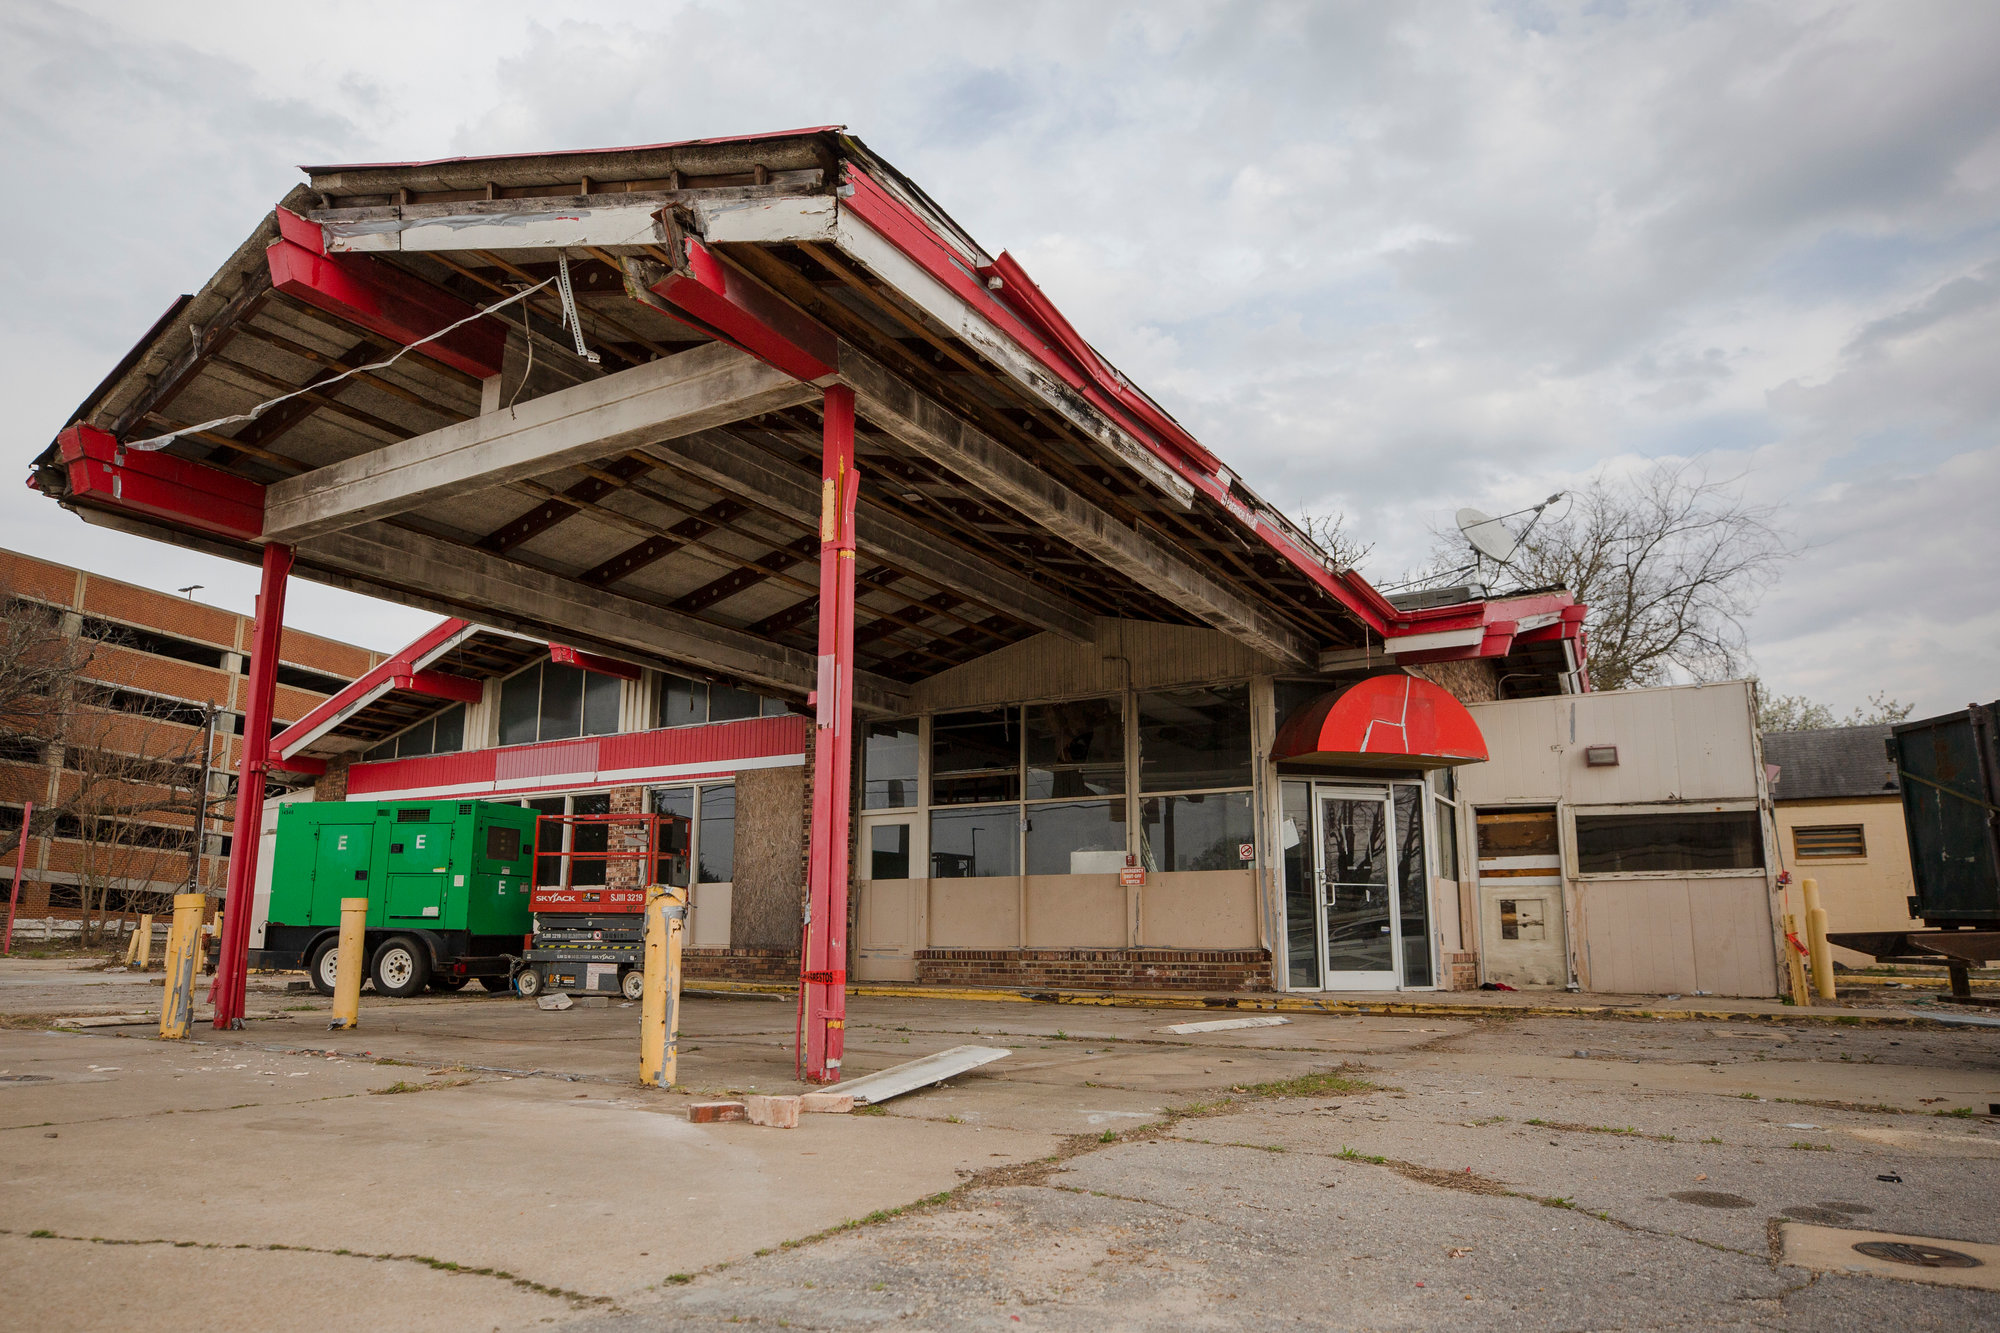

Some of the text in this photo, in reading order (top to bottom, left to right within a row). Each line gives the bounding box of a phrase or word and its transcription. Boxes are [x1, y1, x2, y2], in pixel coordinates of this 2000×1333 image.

[337, 835, 348, 850] E
[415, 834, 427, 849] E
[498, 880, 506, 895] E
[536, 892, 576, 903] SKYJACK
[626, 893, 643, 902] 3219
